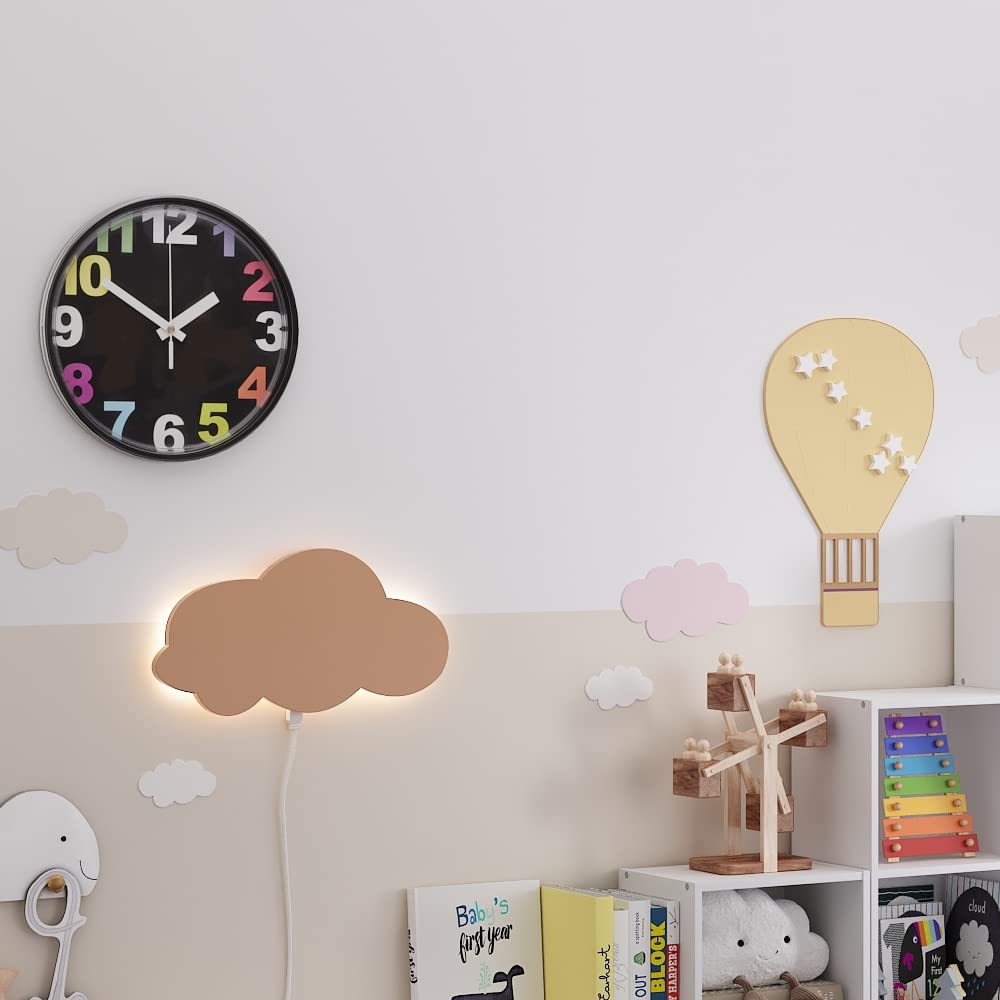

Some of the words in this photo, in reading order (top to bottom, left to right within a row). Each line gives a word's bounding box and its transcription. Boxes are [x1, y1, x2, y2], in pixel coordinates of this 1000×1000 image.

[97, 213, 134, 253] 11
[141, 204, 198, 245] 12
[213, 221, 237, 257] 1
[64, 254, 112, 297] 10
[242, 259, 275, 302] 2
[52, 305, 83, 348] 9
[255, 310, 288, 352] 3
[61, 362, 94, 406] 8
[237, 366, 272, 409] 4
[103, 400, 136, 440] 7
[153, 413, 185, 452] 6
[198, 402, 231, 446] 5
[456, 896, 509, 927] Baby's
[968, 899, 986, 914] cloud
[459, 926, 486, 963] first
[488, 924, 513, 955] year
[650, 921, 666, 993] BLOCK
[931, 954, 941, 965] My
[597, 944, 610, 1000] Earhart
[635, 974, 647, 997] OUT
[668, 944, 678, 993] HARPER'S
[931, 966, 942, 975] First
